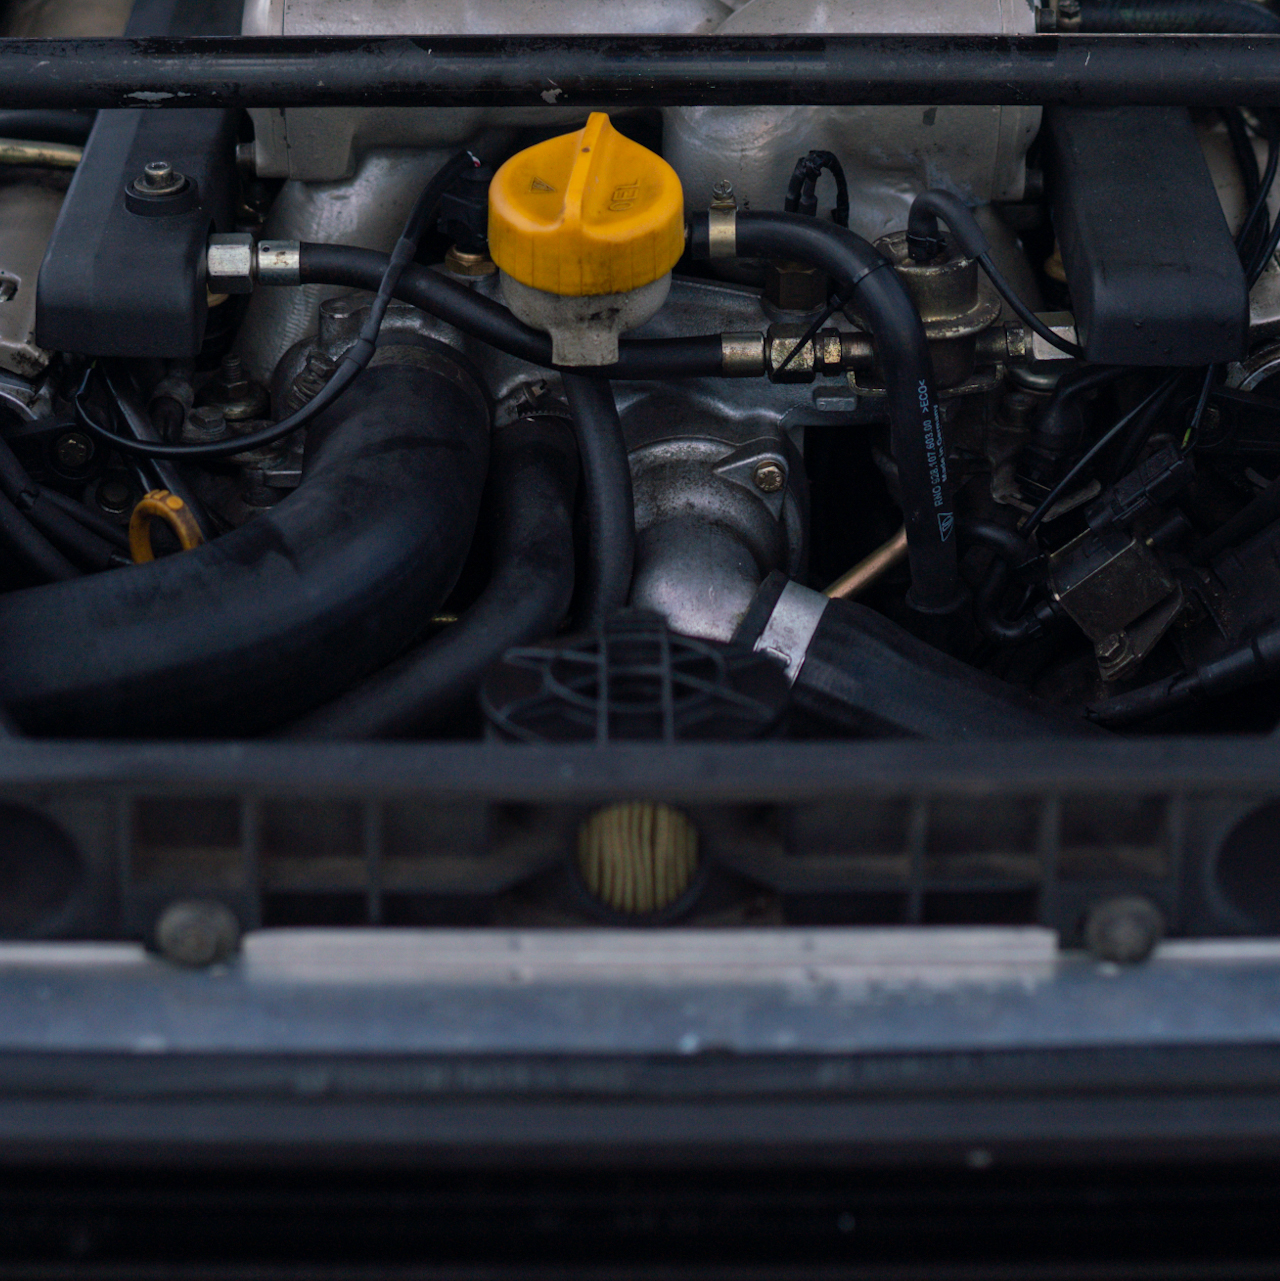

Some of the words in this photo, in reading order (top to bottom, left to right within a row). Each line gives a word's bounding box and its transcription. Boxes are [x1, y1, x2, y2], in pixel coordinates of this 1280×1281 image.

[608, 178, 641, 212] OEL
[933, 405, 942, 446] Germany
[923, 419, 940, 485] 928.107.603.00
